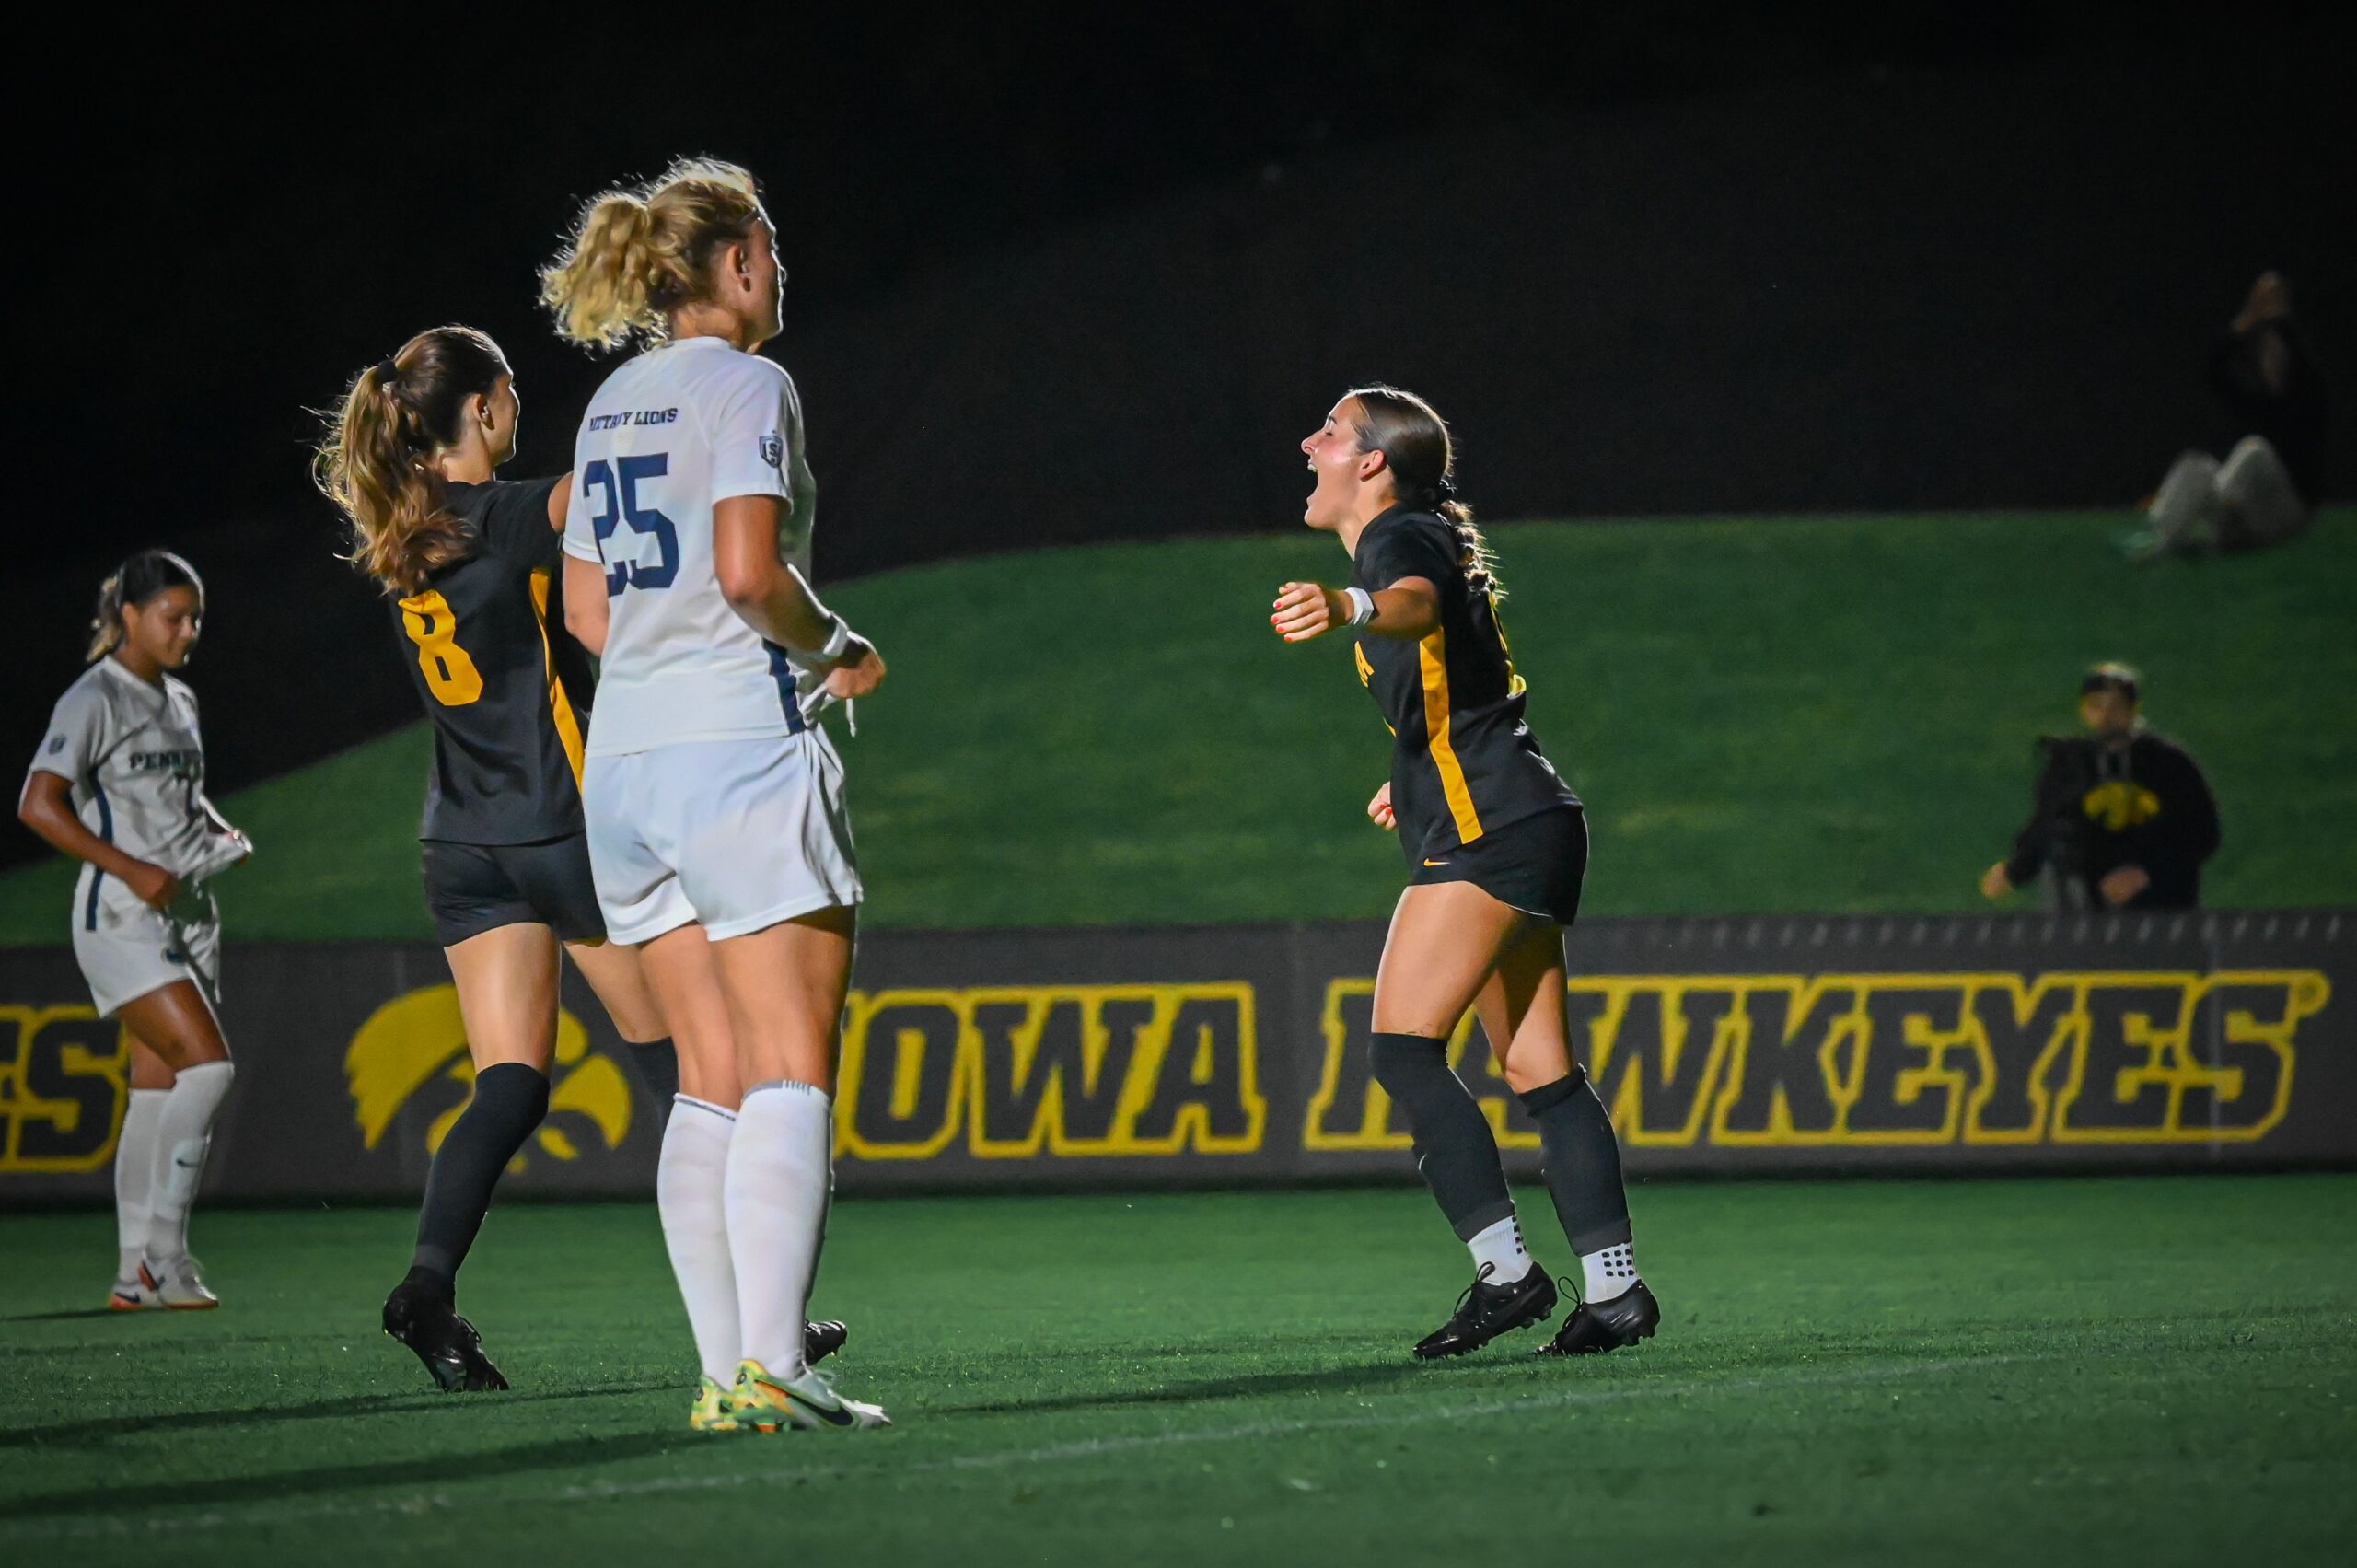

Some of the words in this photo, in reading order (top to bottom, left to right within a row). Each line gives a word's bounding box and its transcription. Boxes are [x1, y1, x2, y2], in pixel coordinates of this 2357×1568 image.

[583, 452, 679, 598] 25
[398, 589, 483, 705] 8
[832, 981, 1266, 1159] OWA
[1304, 970, 2302, 1149] WKEYES
